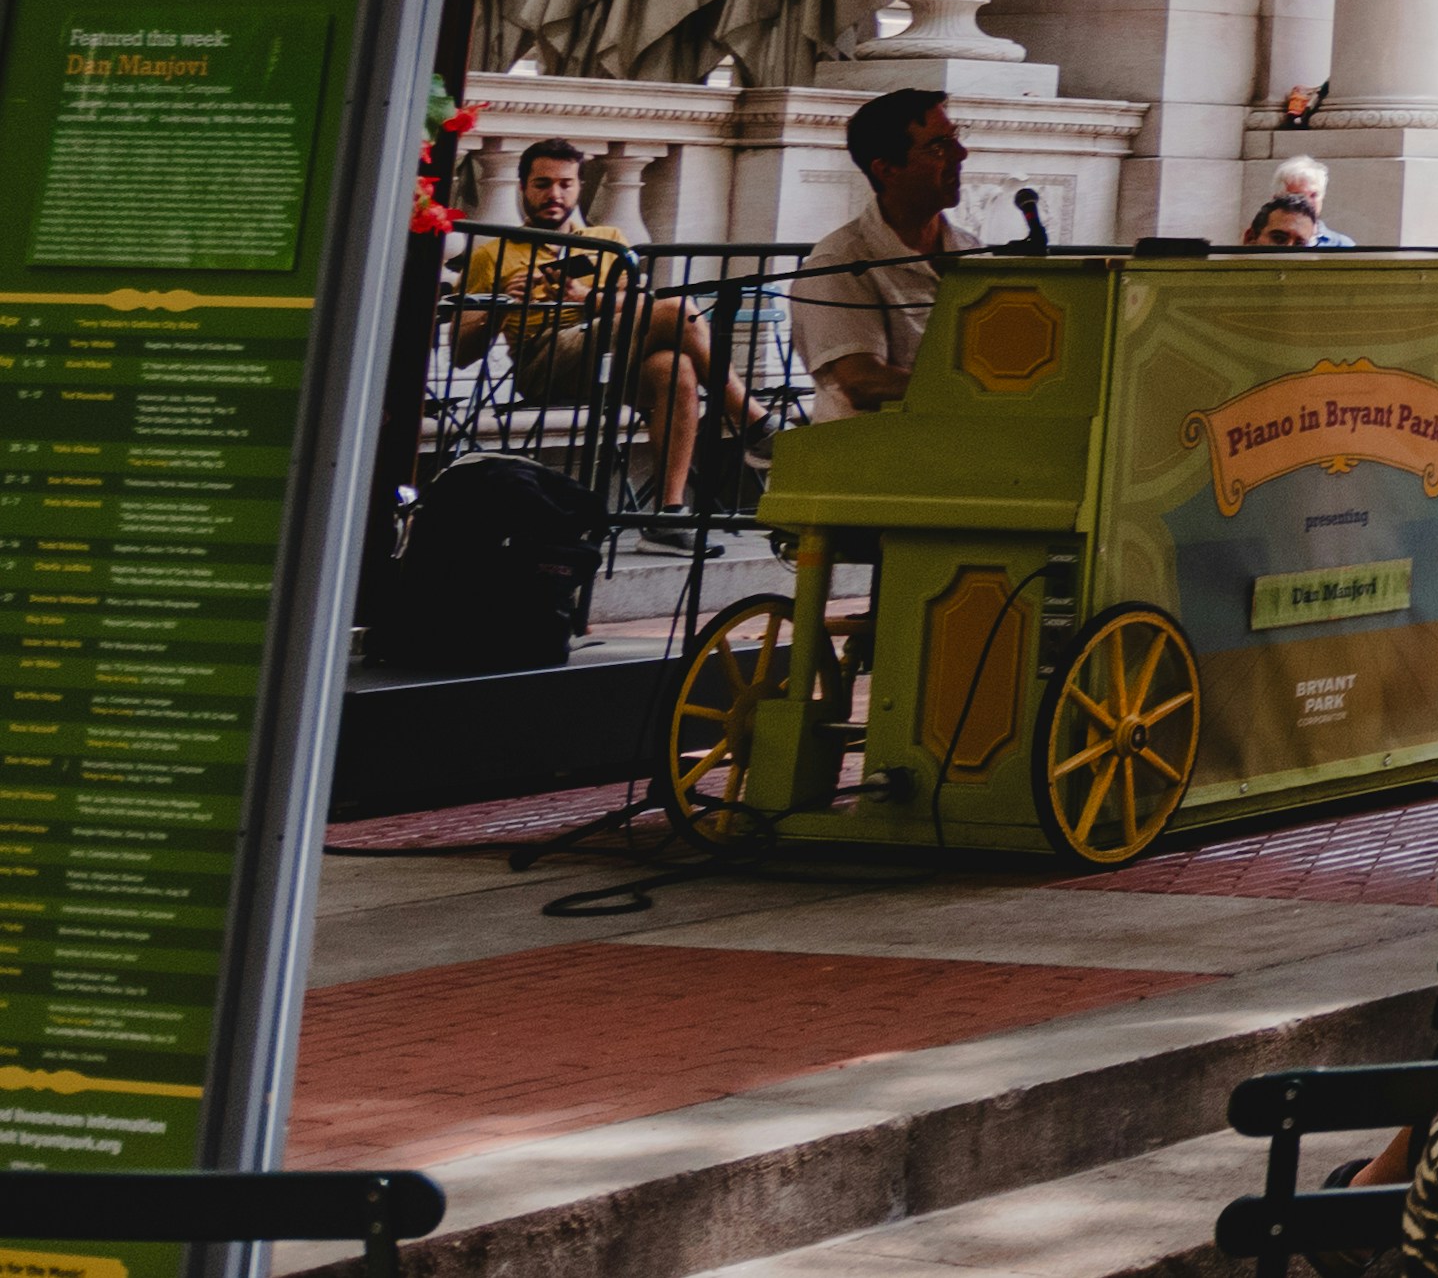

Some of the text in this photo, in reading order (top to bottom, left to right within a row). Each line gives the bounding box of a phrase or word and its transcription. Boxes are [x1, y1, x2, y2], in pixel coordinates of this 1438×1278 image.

[69, 29, 144, 47] Featured
[146, 30, 177, 46] this
[65, 53, 209, 81] Dan Manjovi
[1227, 417, 1295, 457] Piano
[1299, 405, 1321, 432] in
[1324, 401, 1394, 433] Bryant
[1304, 508, 1370, 532] presenting
[1291, 576, 1378, 606] Dan Manjovi
[1296, 674, 1358, 698] BRYANT
[1304, 693, 1346, 714] PARK
